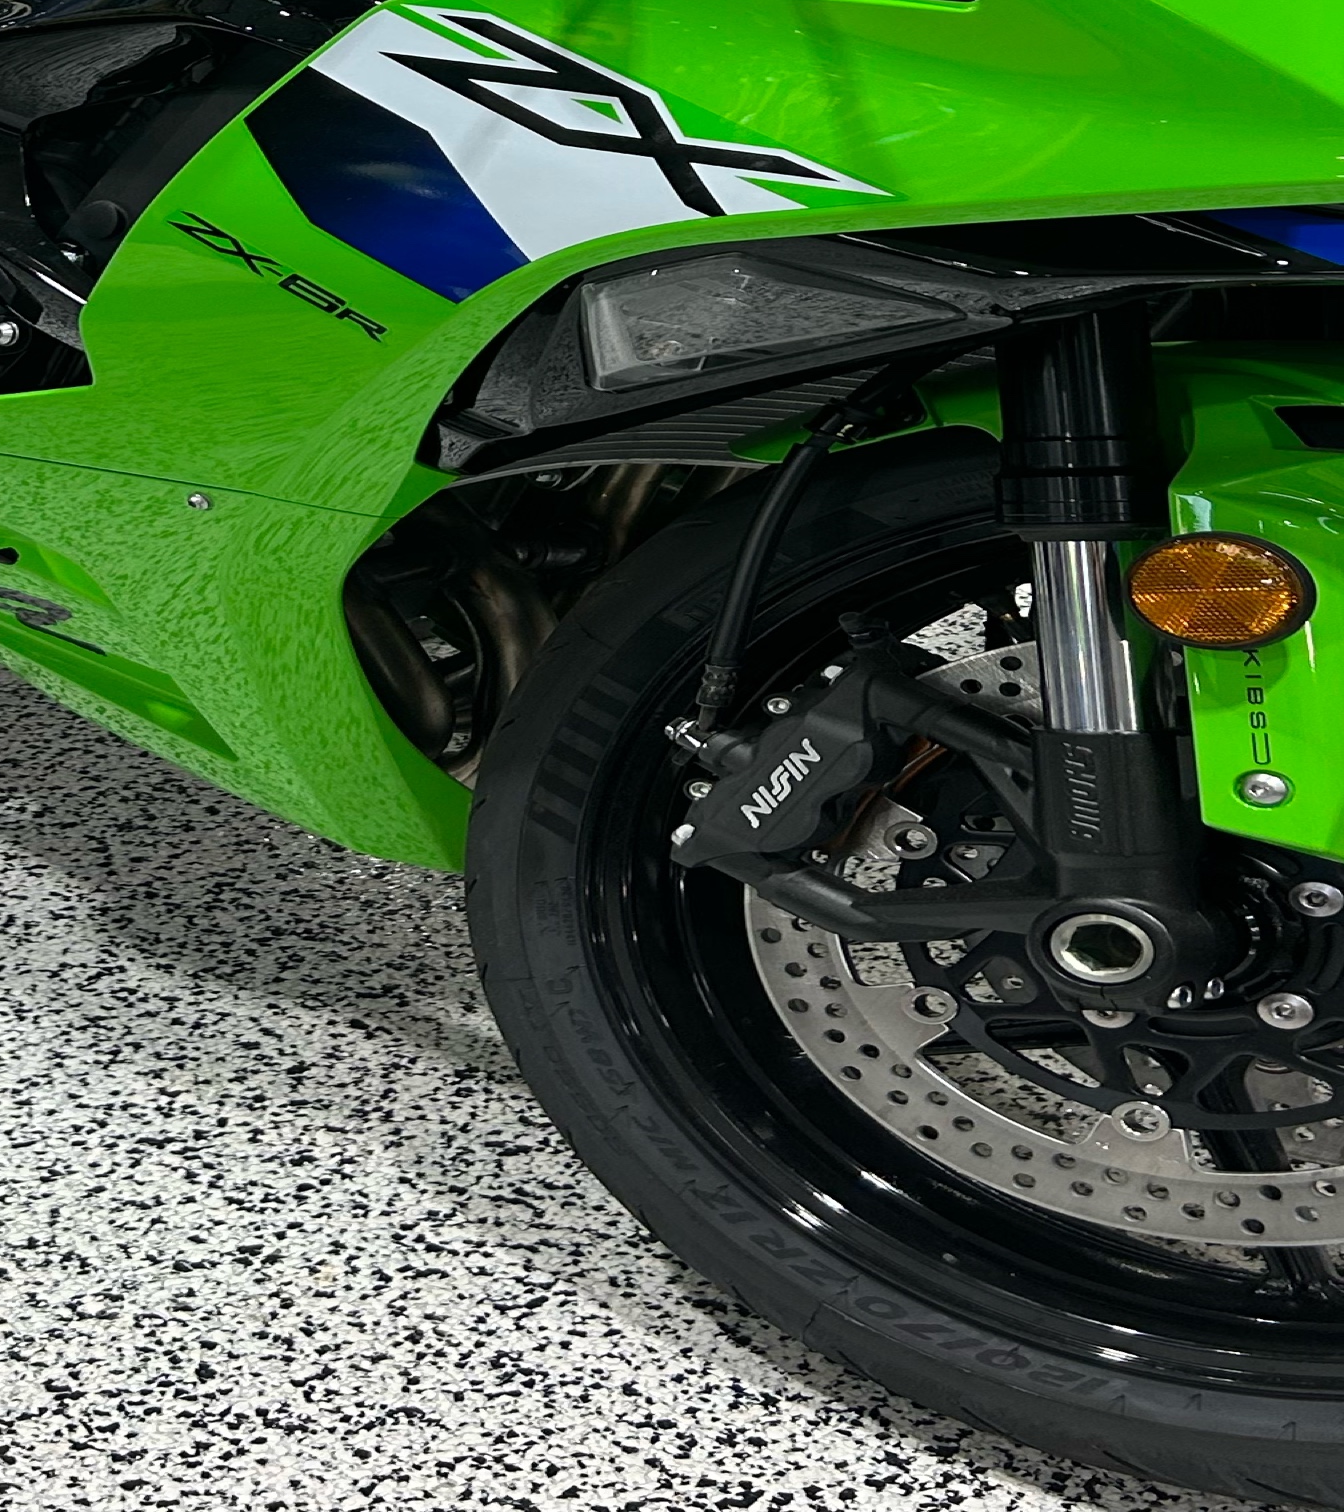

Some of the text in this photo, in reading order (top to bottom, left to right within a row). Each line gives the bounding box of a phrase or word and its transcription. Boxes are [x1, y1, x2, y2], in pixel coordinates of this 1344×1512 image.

[378, 9, 851, 218] ZX
[168, 213, 389, 343] ZX-6R
[740, 737, 821, 829] NISSIN
